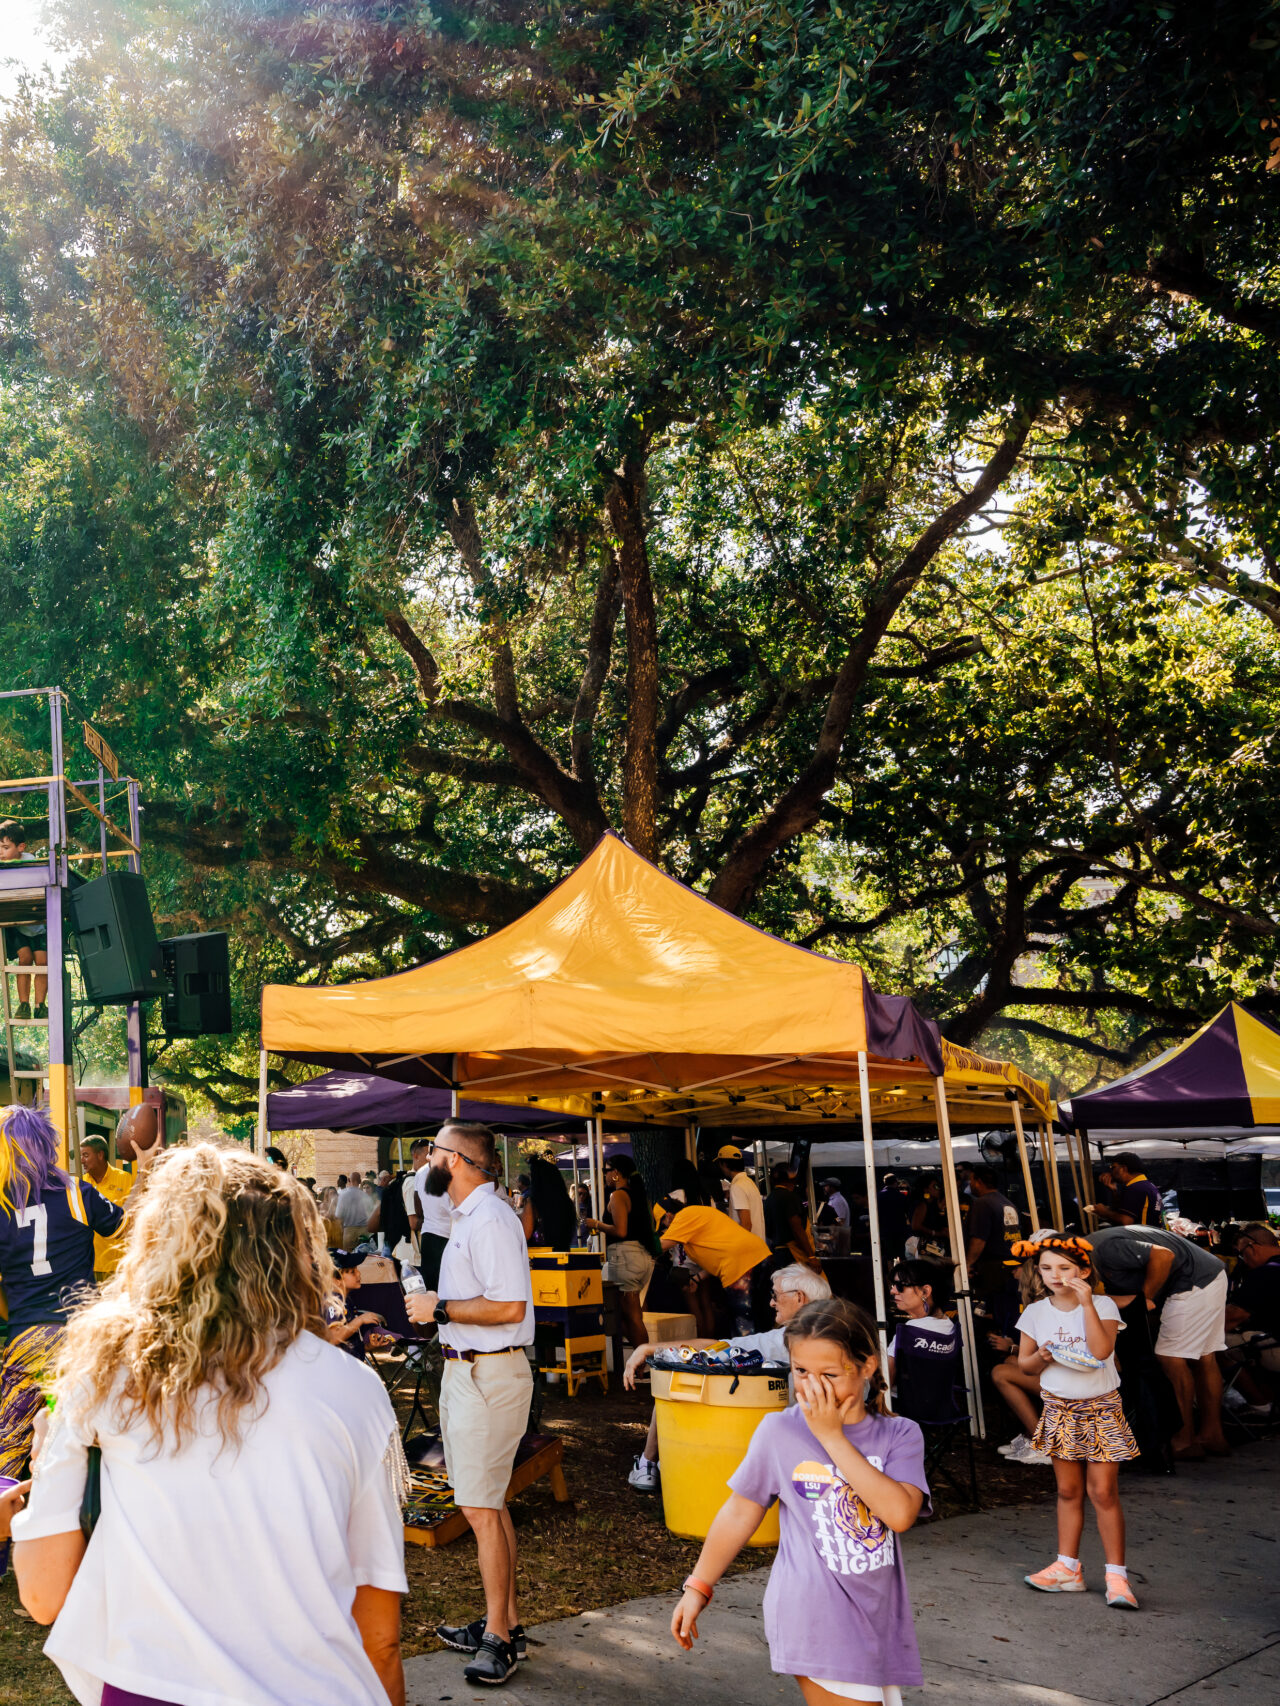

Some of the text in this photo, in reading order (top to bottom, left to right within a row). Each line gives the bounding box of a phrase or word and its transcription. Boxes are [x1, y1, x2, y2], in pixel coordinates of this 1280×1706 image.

[14, 1203, 53, 1277] 7
[794, 1472, 831, 1483] FOREVER
[804, 1481, 820, 1490] LSU
